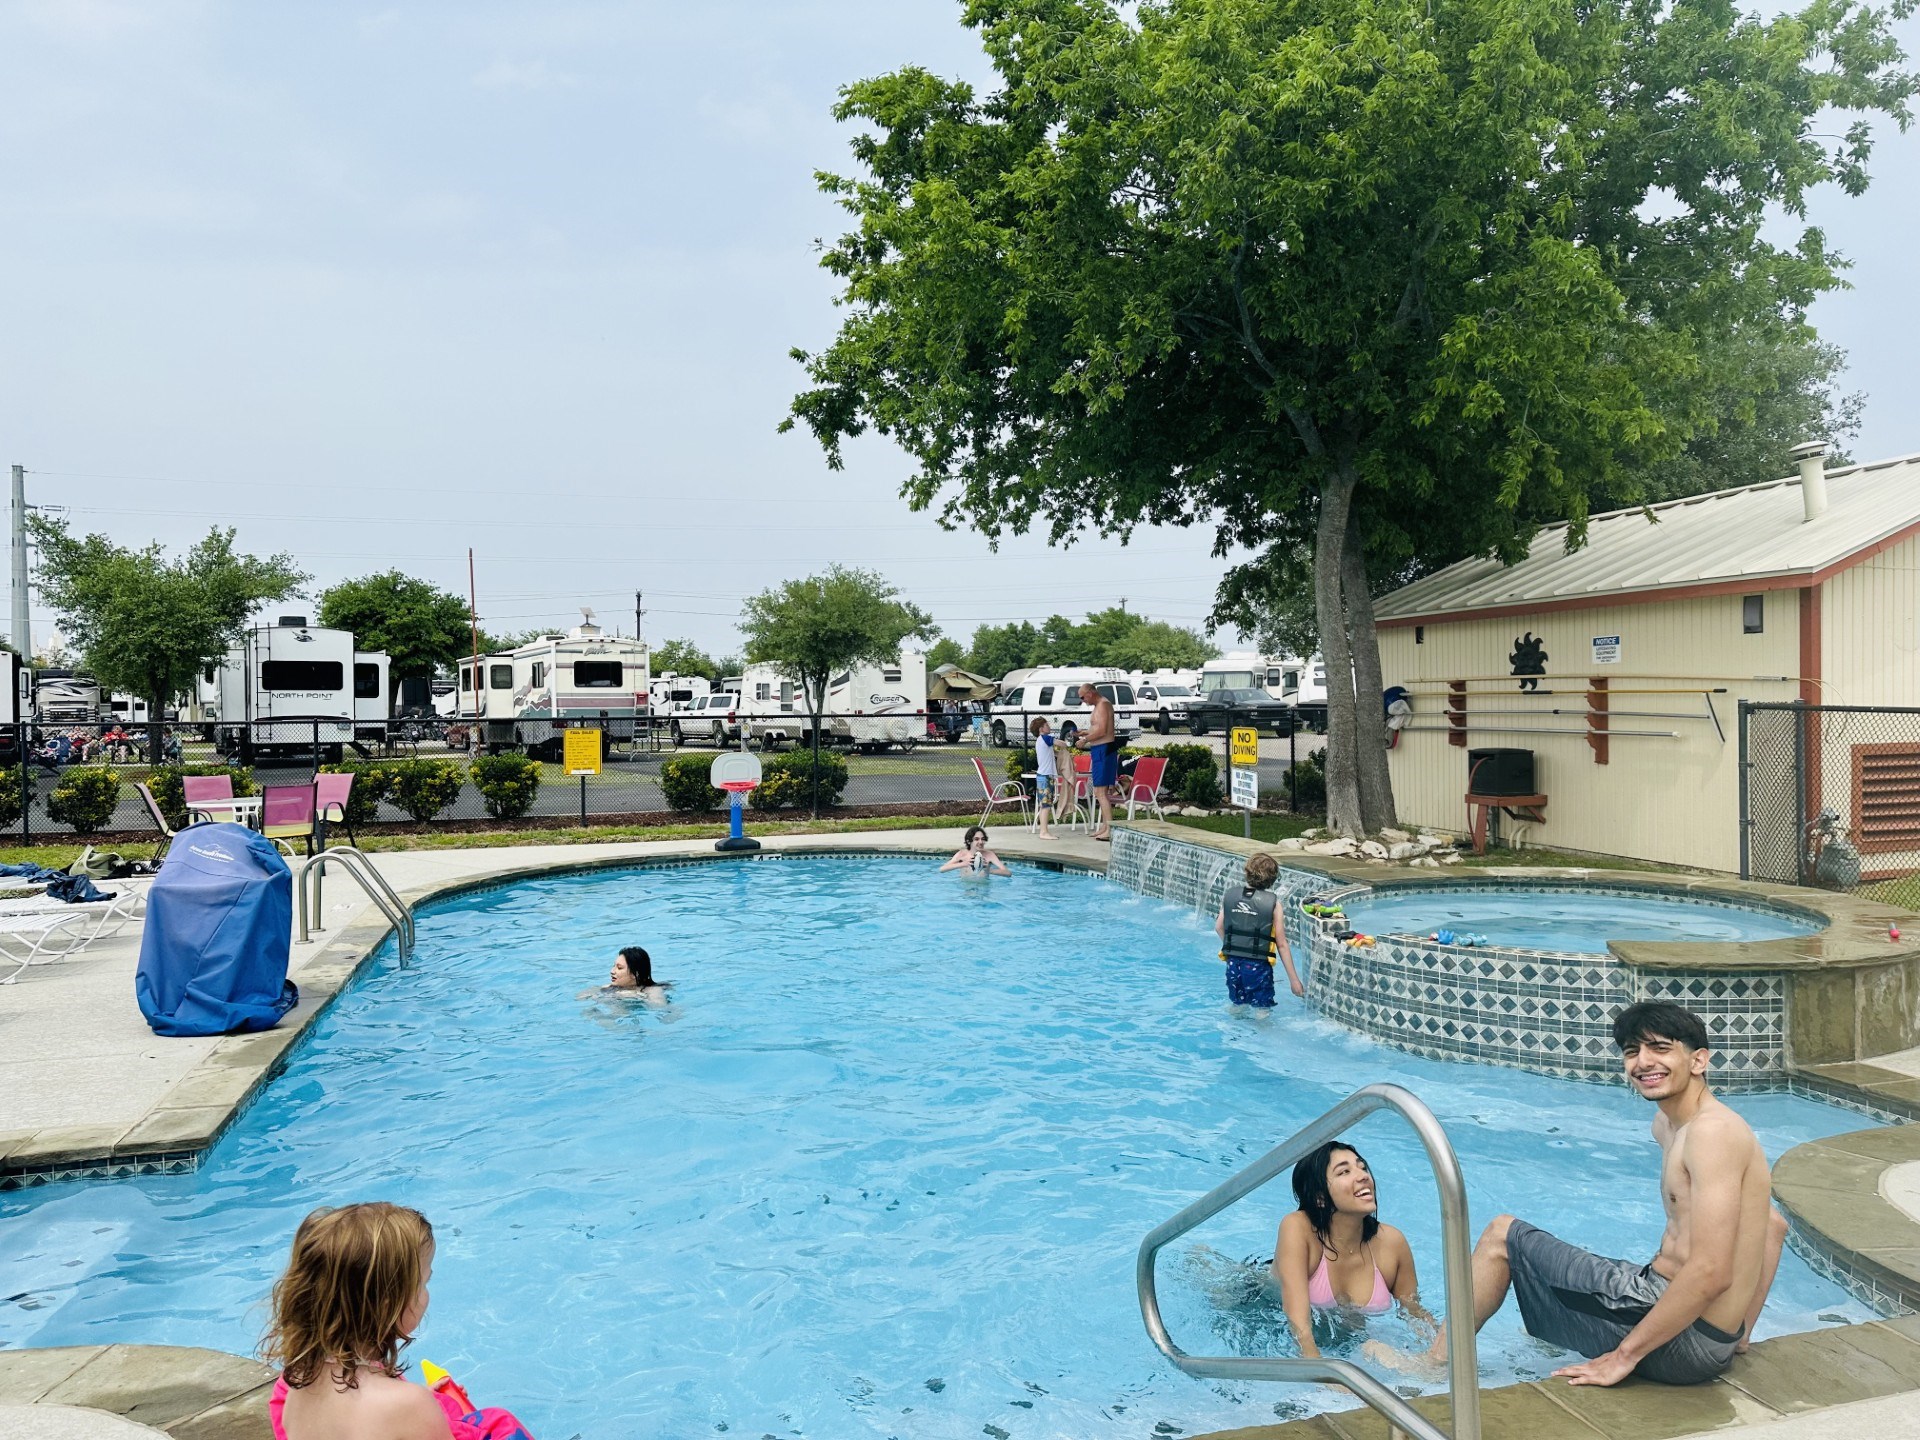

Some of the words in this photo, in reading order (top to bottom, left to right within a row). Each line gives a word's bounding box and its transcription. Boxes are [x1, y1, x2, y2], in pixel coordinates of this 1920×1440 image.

[1596, 637, 1616, 645] NOTICE
[870, 694, 900, 704] CRUISER
[1238, 733, 1251, 743] NO
[1234, 745, 1255, 755] DIVING
